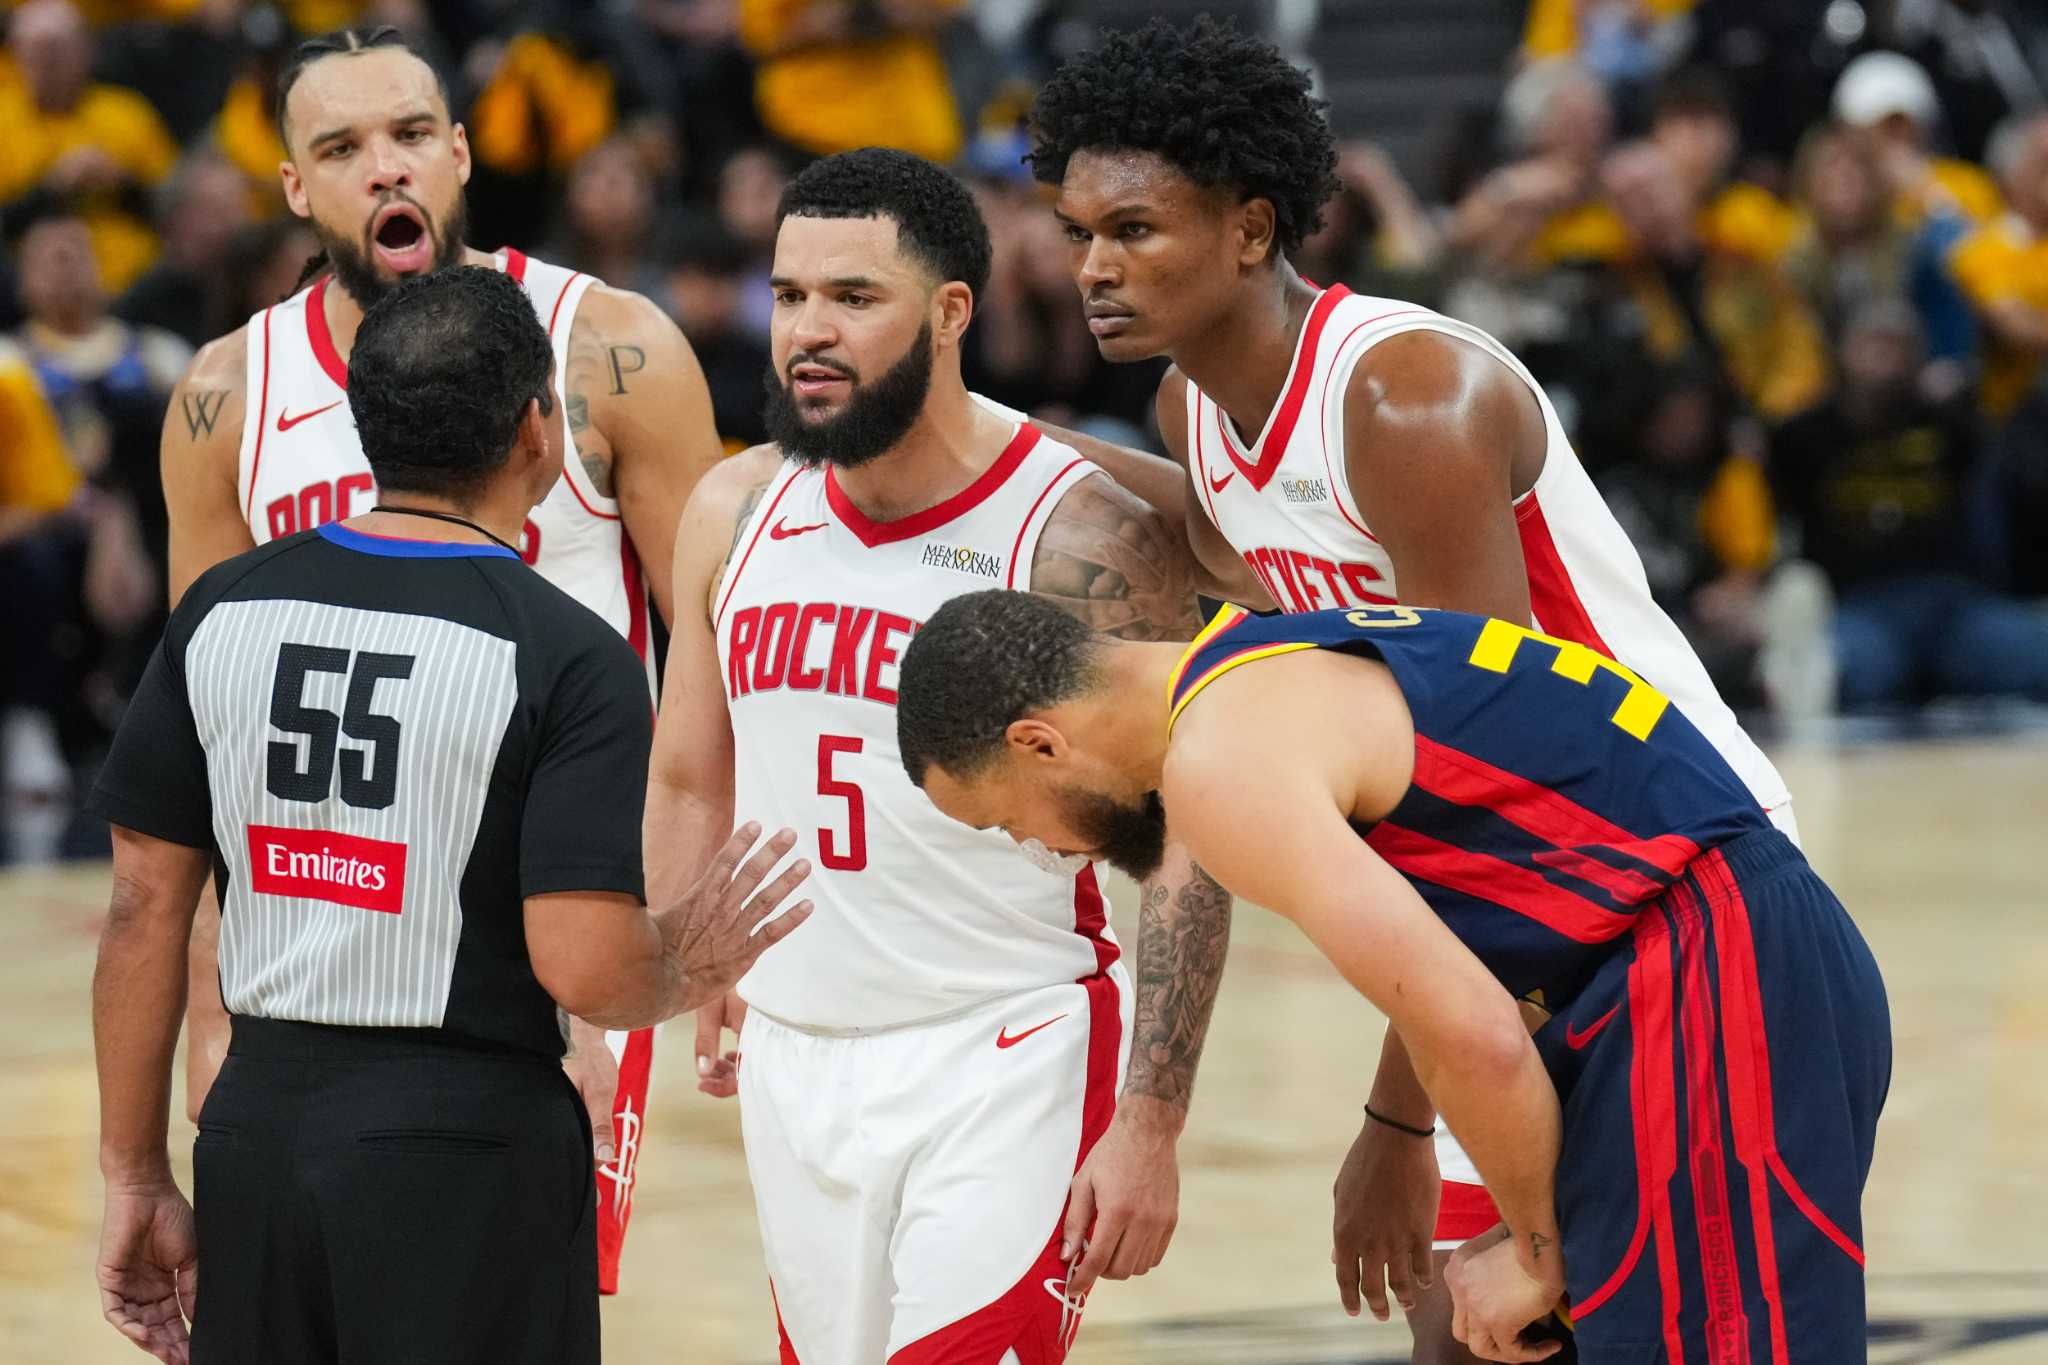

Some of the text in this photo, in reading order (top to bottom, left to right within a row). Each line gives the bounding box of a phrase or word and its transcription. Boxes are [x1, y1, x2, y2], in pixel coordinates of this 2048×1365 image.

[608, 344, 646, 396] P
[181, 389, 231, 442] W
[922, 553, 1001, 578] HERMANN
[923, 543, 1002, 568] MEMORIAL
[728, 601, 924, 706] ROCKE
[266, 642, 416, 811] 55
[816, 733, 868, 872] 5
[265, 843, 386, 891] Emirates
